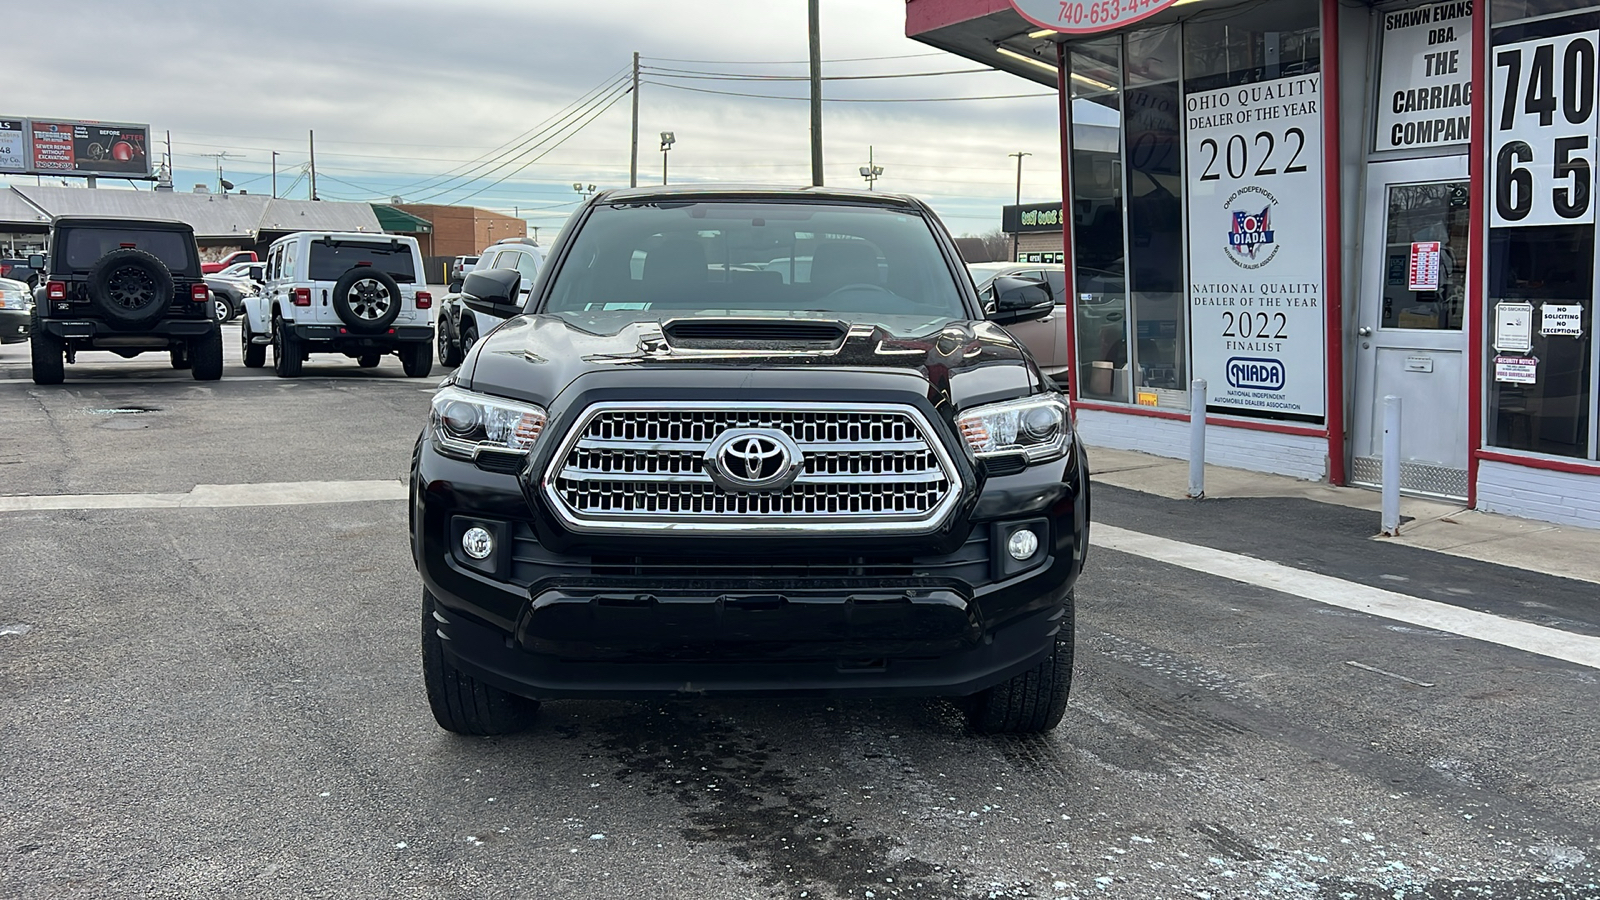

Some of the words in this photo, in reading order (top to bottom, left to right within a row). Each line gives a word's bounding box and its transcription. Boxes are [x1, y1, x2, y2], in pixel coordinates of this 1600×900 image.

[1386, 9, 1430, 30] SHAWN
[1433, 1, 1473, 22] EVANS
[1428, 27, 1457, 45] DBA.
[1424, 50, 1458, 77] THE
[1497, 38, 1595, 130] 740
[1188, 93, 1230, 112] OHIO
[1238, 78, 1318, 106] QUALITY
[1190, 112, 1233, 130] DEALER
[1237, 110, 1252, 123] OF
[1255, 106, 1280, 120] THE
[1282, 100, 1317, 117] YEAR
[1200, 128, 1307, 181] 2022
[1224, 192, 1237, 209] OHIO
[1237, 186, 1279, 206] INDEPENDENT
[1234, 232, 1266, 244] OIADA
[1193, 284, 1254, 294] NATIONAL
[1260, 284, 1318, 295] QUALITY
[1194, 298, 1235, 306] DEALER
[1240, 298, 1254, 306] OF
[1259, 298, 1281, 306] THE
[1286, 298, 1317, 307] YEAR
[1222, 311, 1288, 339] 2022
[1226, 341, 1282, 352] FINALIST
[1231, 364, 1280, 384] NIADA
[1252, 392, 1286, 400] INDEPENDENT
[1266, 401, 1300, 410] ASSOCIATION
